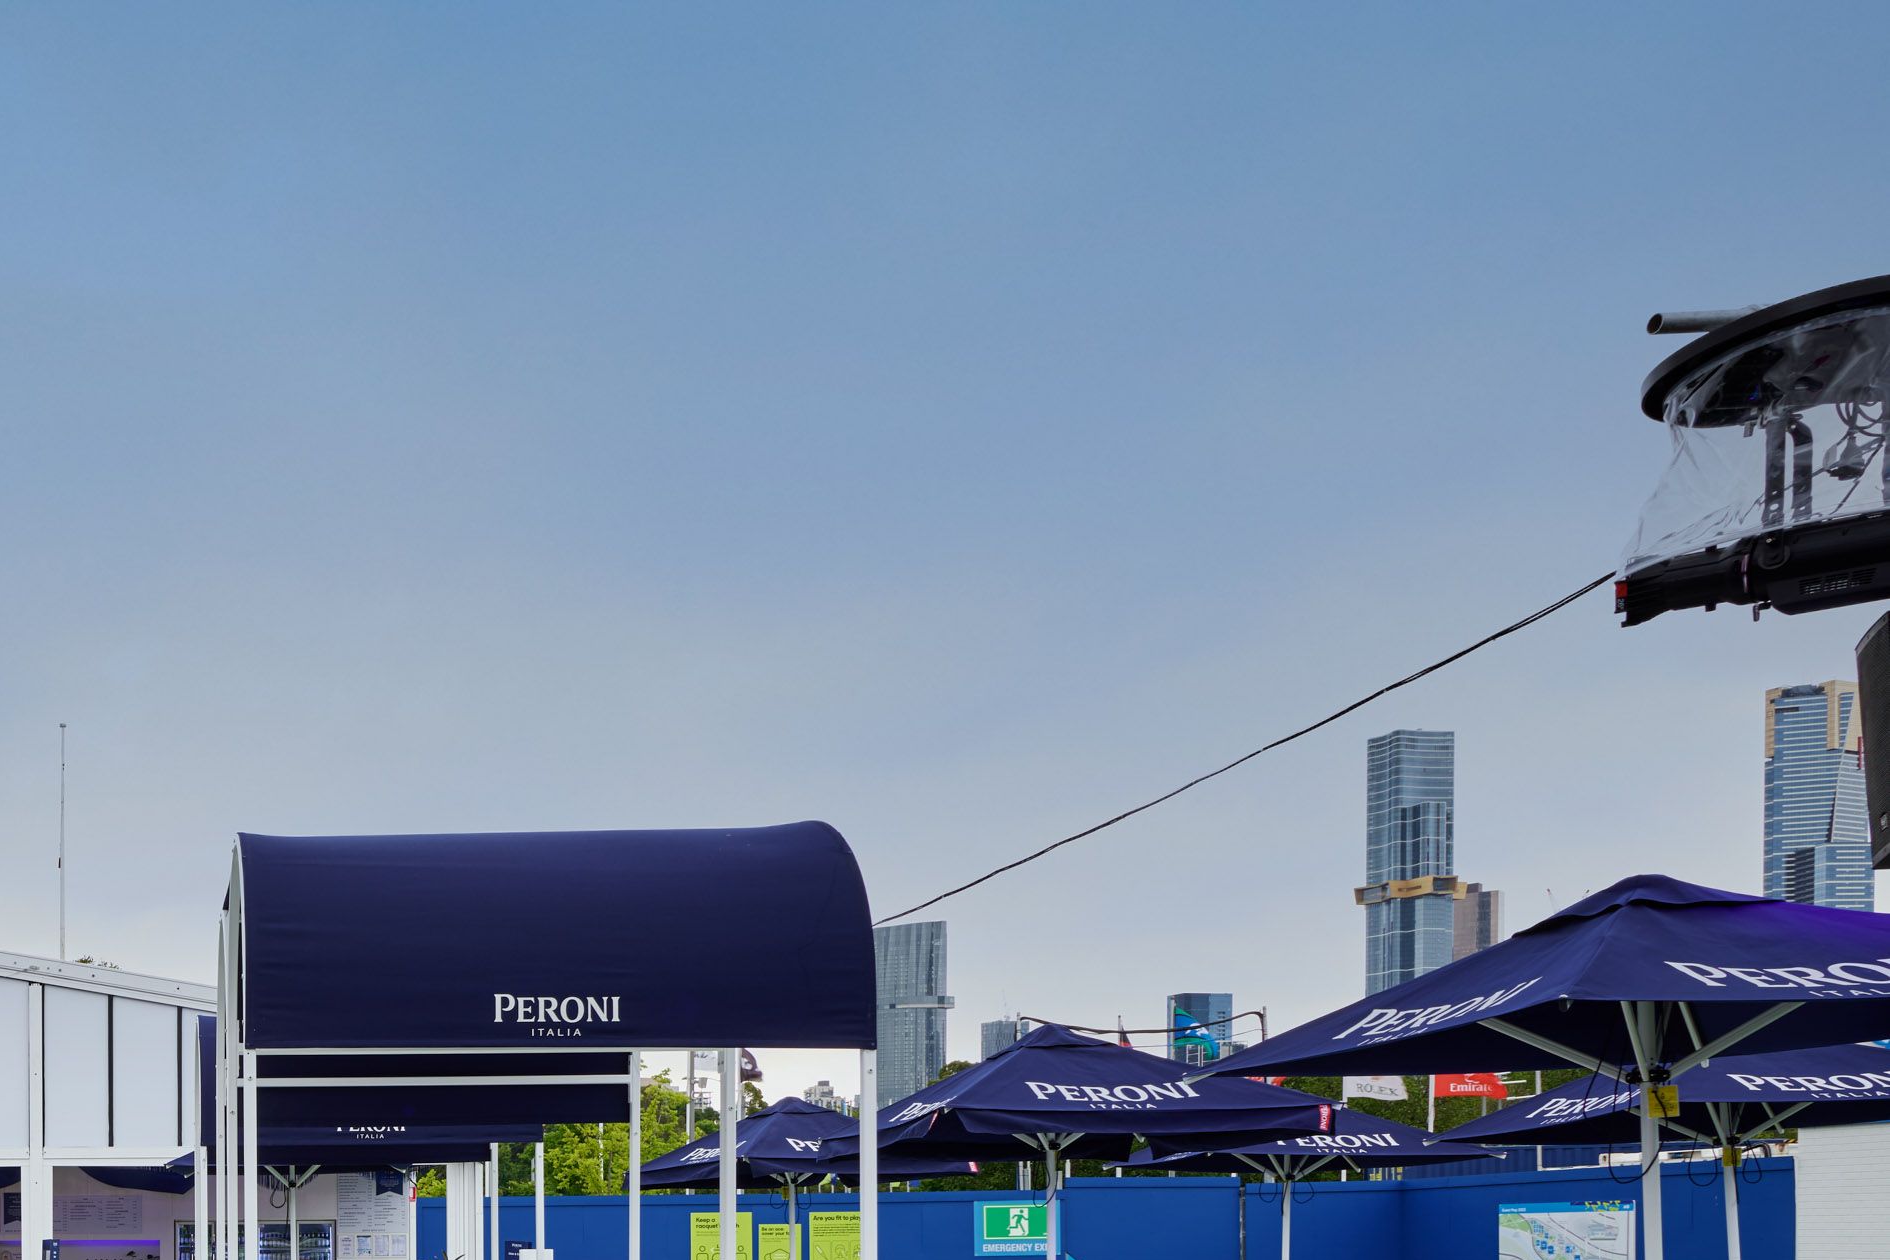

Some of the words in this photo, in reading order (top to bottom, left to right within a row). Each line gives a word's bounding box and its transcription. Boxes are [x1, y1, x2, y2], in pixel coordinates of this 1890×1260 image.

[1664, 957, 1890, 988] PERO
[1809, 988, 1890, 997] ITAL
[494, 993, 621, 1023] PERONI
[1332, 976, 1543, 1040] PERONI
[531, 1028, 582, 1036] ITALIA
[1025, 1081, 1200, 1102] PERONI
[1811, 1091, 1890, 1099] ITALIA
[1276, 1133, 1400, 1148] ERONI
[982, 1243, 1033, 1252] EMERGENCY
